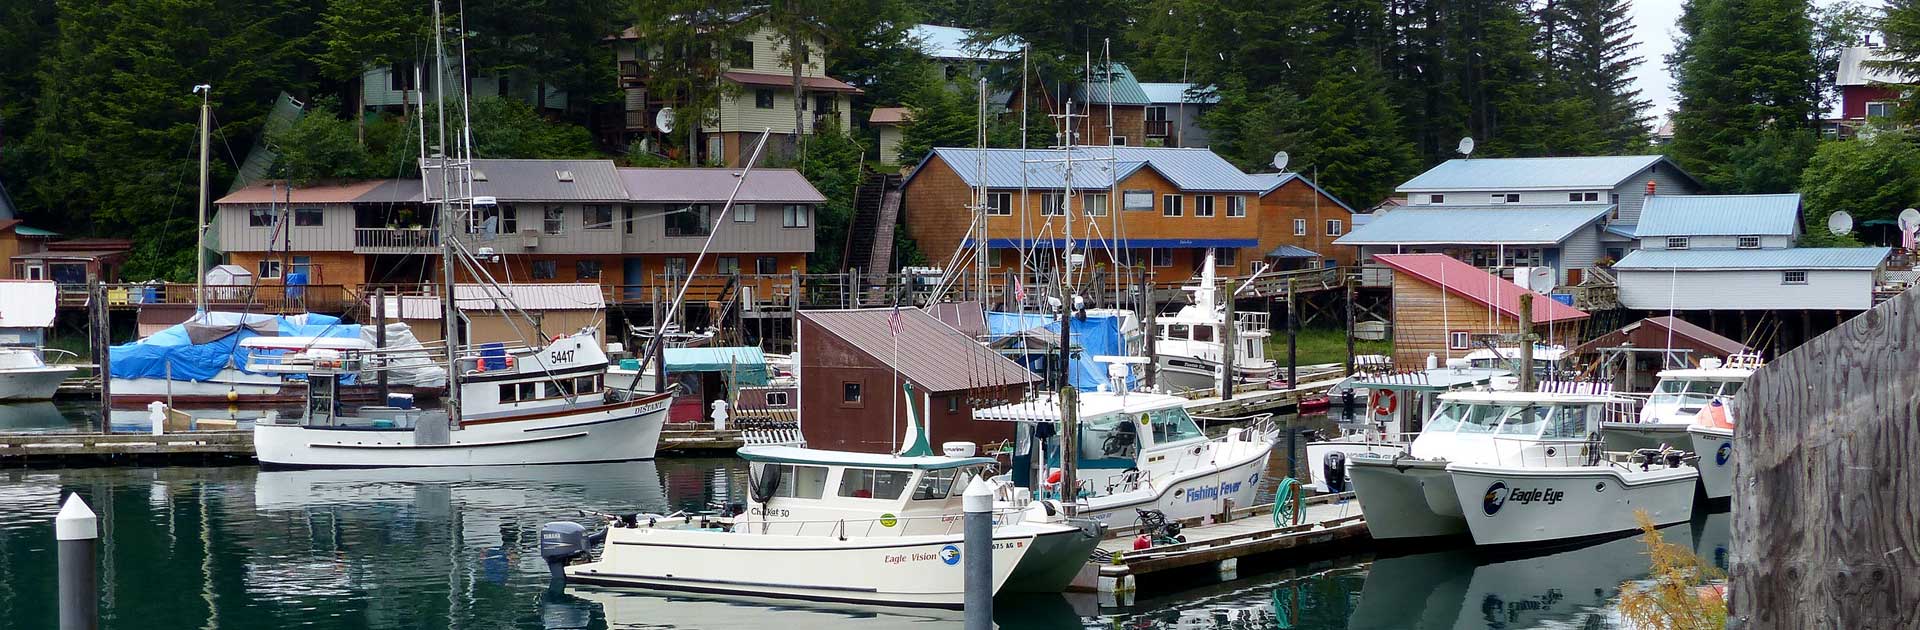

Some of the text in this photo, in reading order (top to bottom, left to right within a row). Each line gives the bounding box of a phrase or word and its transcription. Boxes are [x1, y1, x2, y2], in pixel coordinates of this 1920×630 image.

[551, 350, 574, 364] 54417
[634, 401, 663, 414] DISTANT
[1186, 481, 1242, 503] Fishing Fever
[1509, 488, 1564, 504] Eagle Eye
[780, 509, 790, 518] 30
[884, 552, 937, 564] Eagle Vision
